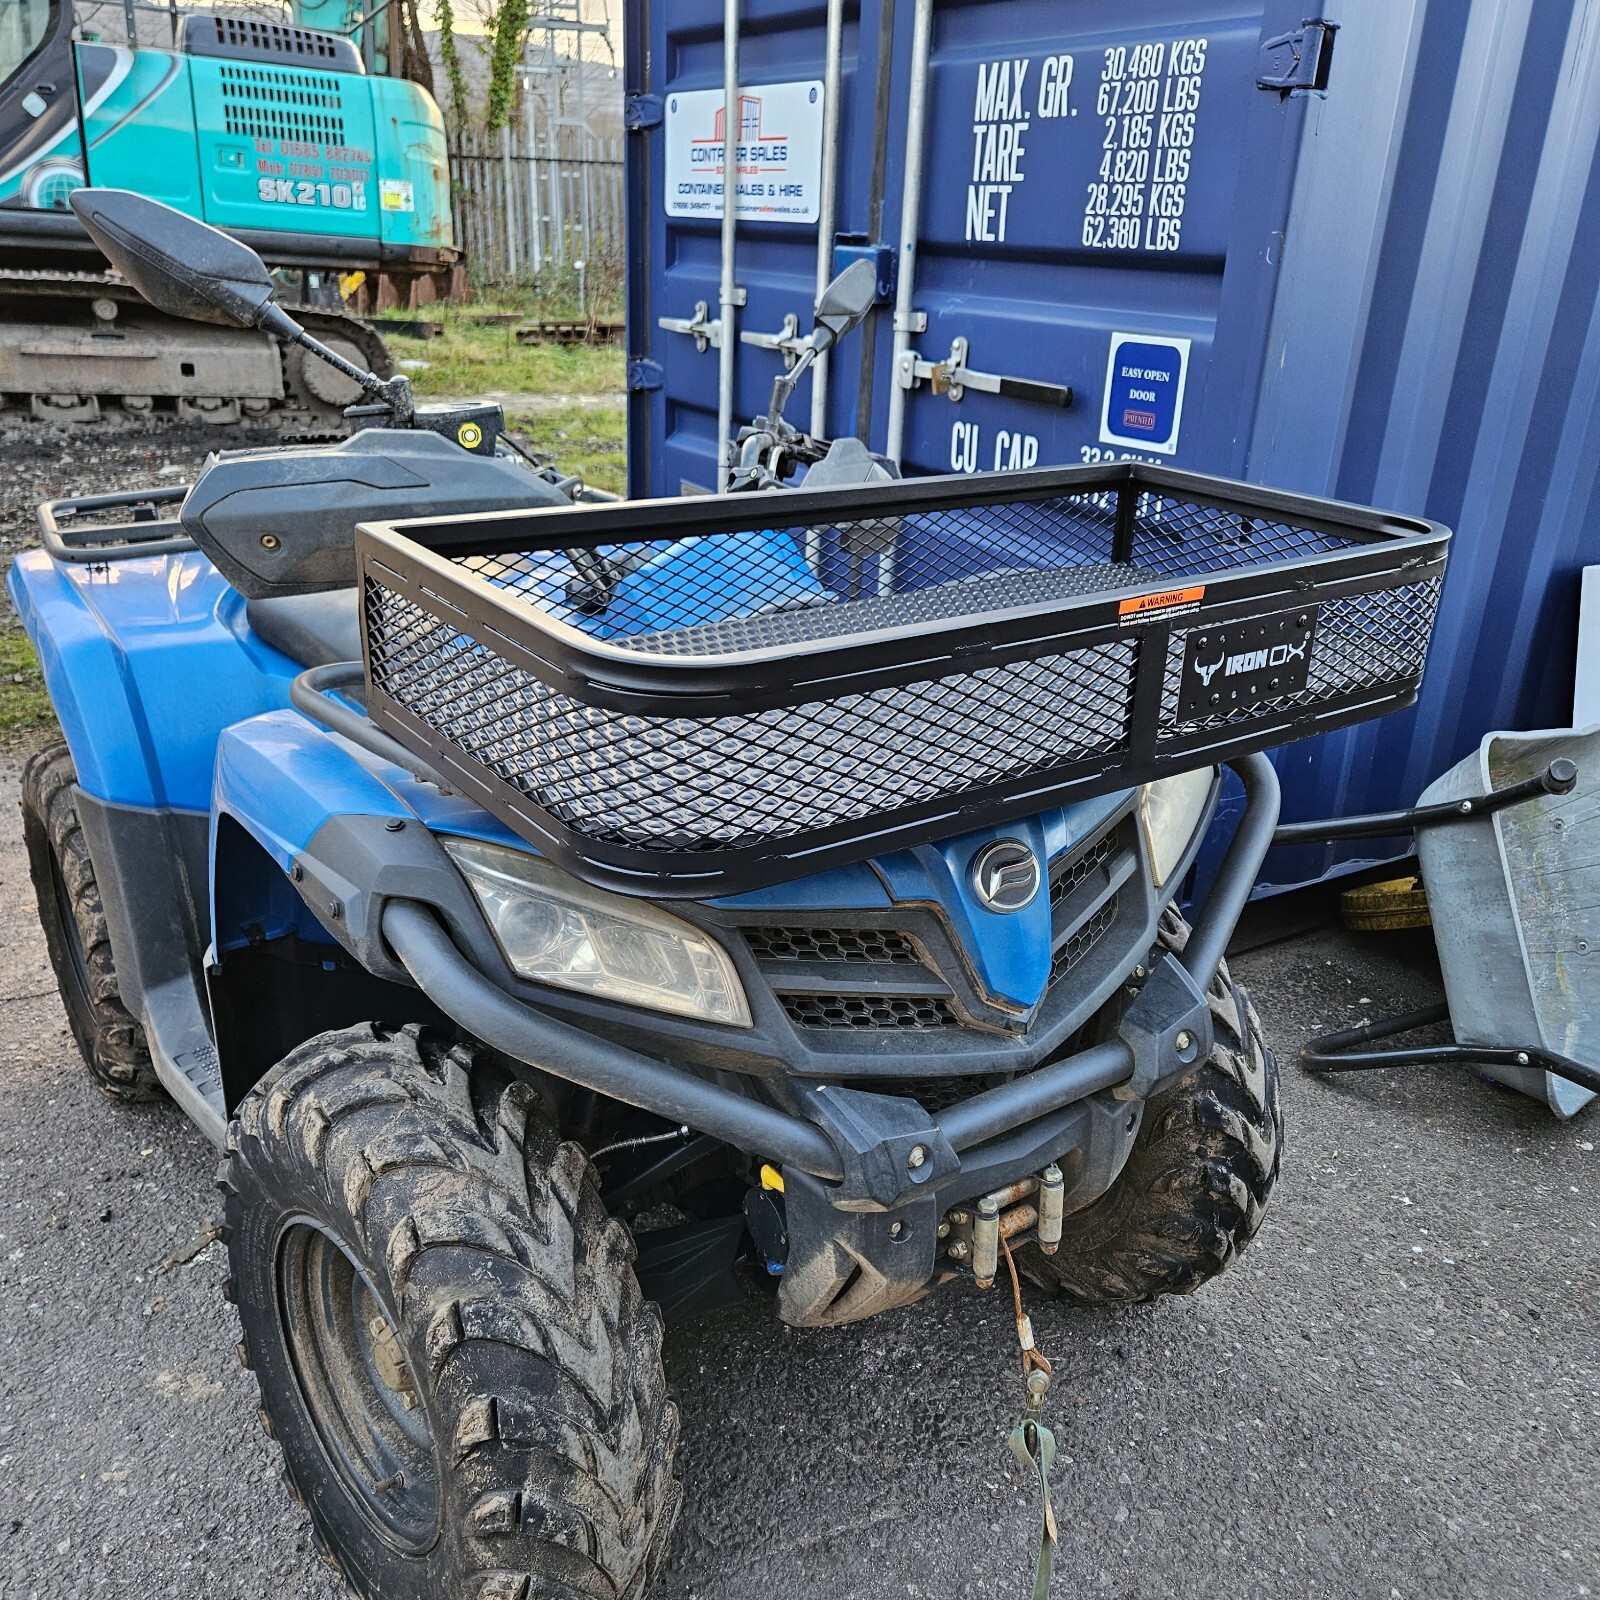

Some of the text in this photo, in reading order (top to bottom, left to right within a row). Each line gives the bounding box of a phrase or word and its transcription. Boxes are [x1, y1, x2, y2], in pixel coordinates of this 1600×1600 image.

[1101, 38, 1208, 82] 30,480 KGS
[974, 55, 1078, 122] MAX. GR.
[1096, 76, 1202, 116] 67,200 LBS
[1102, 112, 1196, 150] 2,185 KGS
[691, 145, 788, 162] CONTAER SALES
[972, 122, 1030, 182] TARE
[1099, 149, 1192, 184] 4,820 LBS
[257, 176, 352, 209] SK210
[678, 183, 725, 195] CONTAINE
[768, 184, 775, 196] &
[778, 184, 803, 197] HIRE
[1085, 183, 1186, 217] 28,295 KGS
[965, 184, 1013, 242] NET
[1081, 215, 1181, 251] 62,380 LBS
[1121, 366, 1170, 382] EASY OPEN
[1128, 388, 1156, 402] DOOR
[1125, 413, 1154, 427] PATENTED
[1147, 593, 1184, 607] WARNING
[1225, 640, 1307, 677] IRON OX
